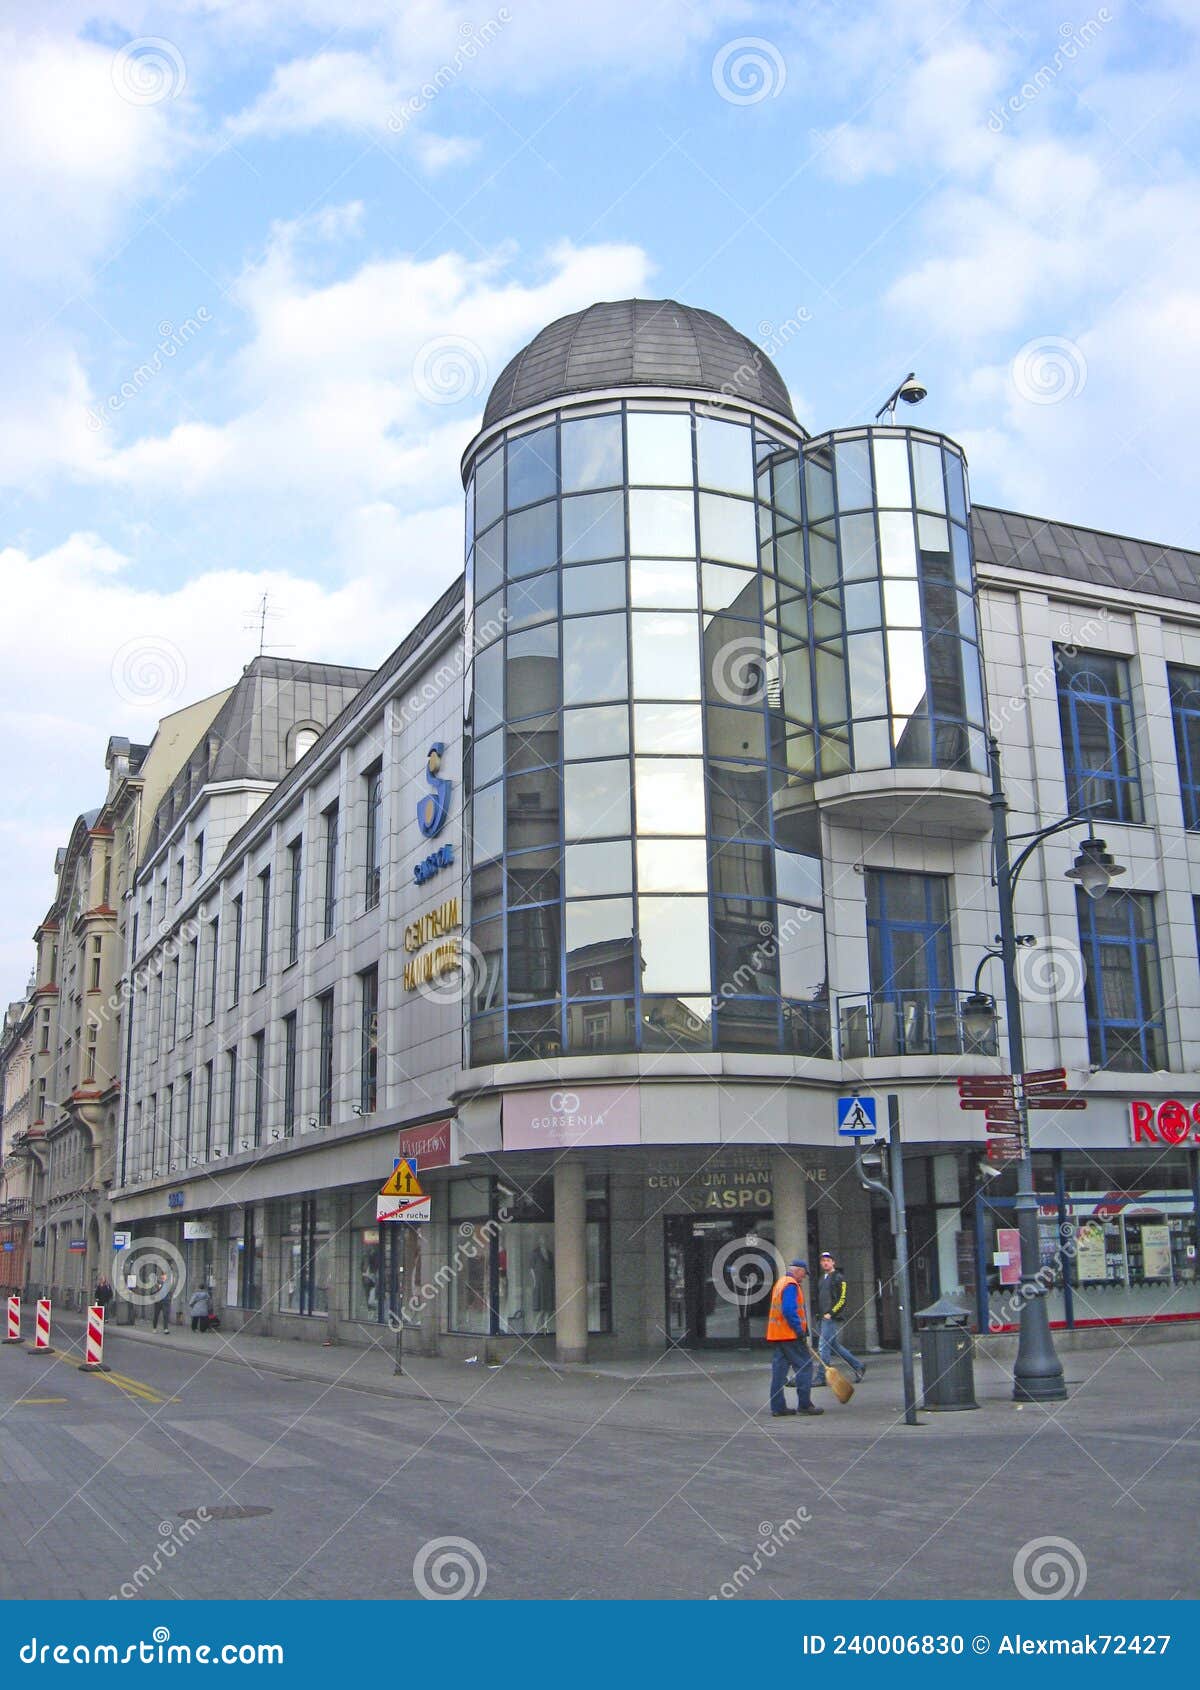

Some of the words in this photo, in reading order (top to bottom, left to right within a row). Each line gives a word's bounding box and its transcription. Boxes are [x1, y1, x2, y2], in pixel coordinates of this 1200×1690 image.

[405, 897, 460, 952] CENTRUM
[531, 1115, 605, 1129] GORSENIA
[648, 1173, 726, 1188] CENUM
